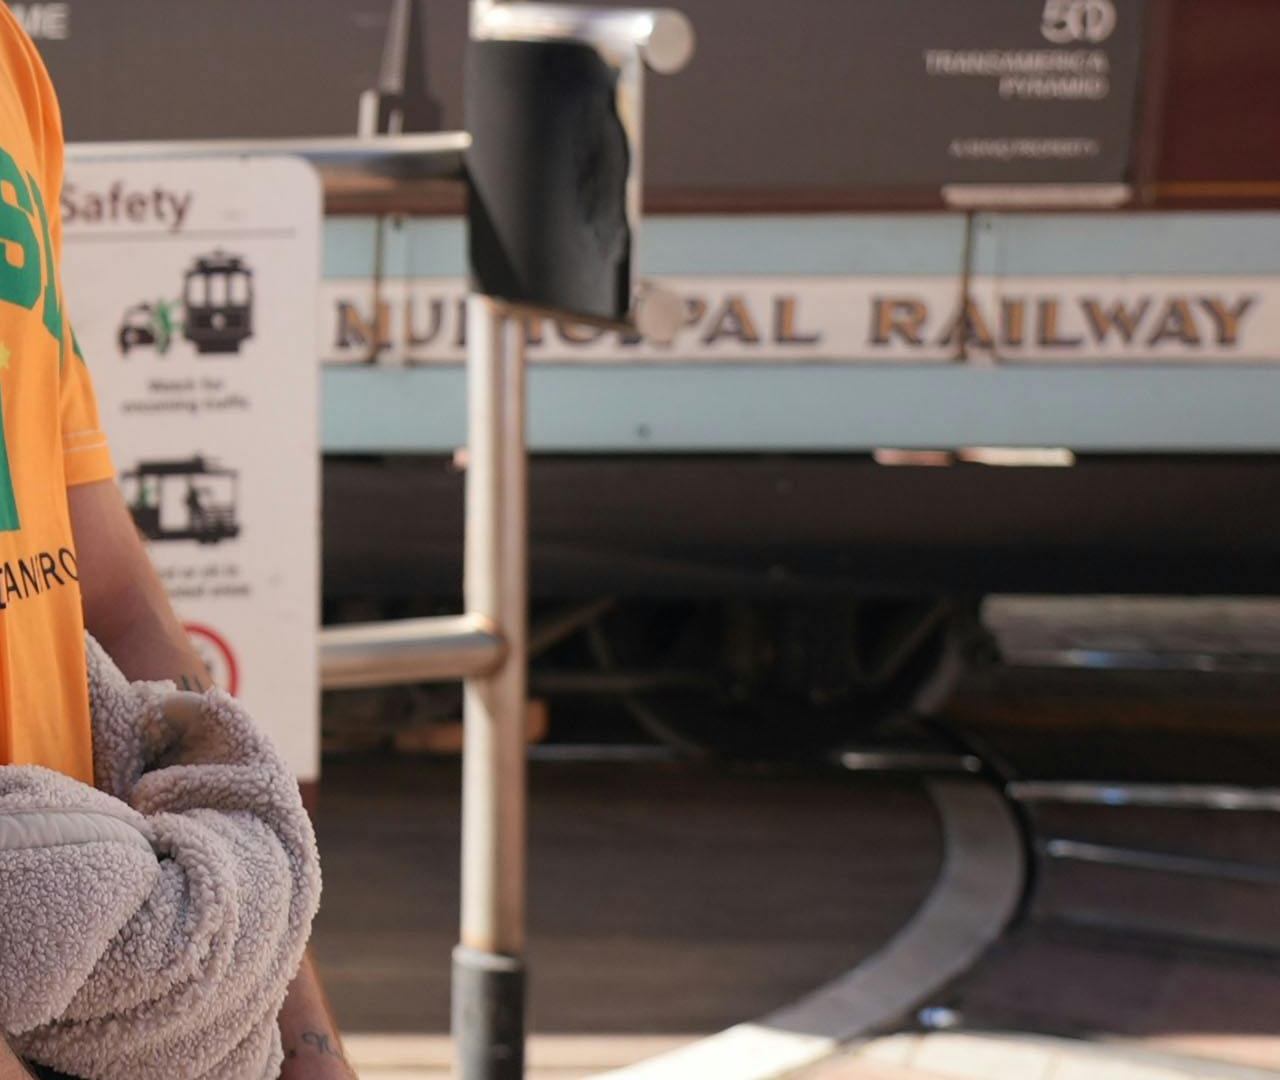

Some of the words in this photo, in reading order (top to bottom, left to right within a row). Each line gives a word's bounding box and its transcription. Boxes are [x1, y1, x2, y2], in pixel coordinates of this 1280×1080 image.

[999, 76, 1107, 100] PYRAMID
[61, 181, 193, 233] Safety
[867, 294, 1258, 348] RAILWAY
